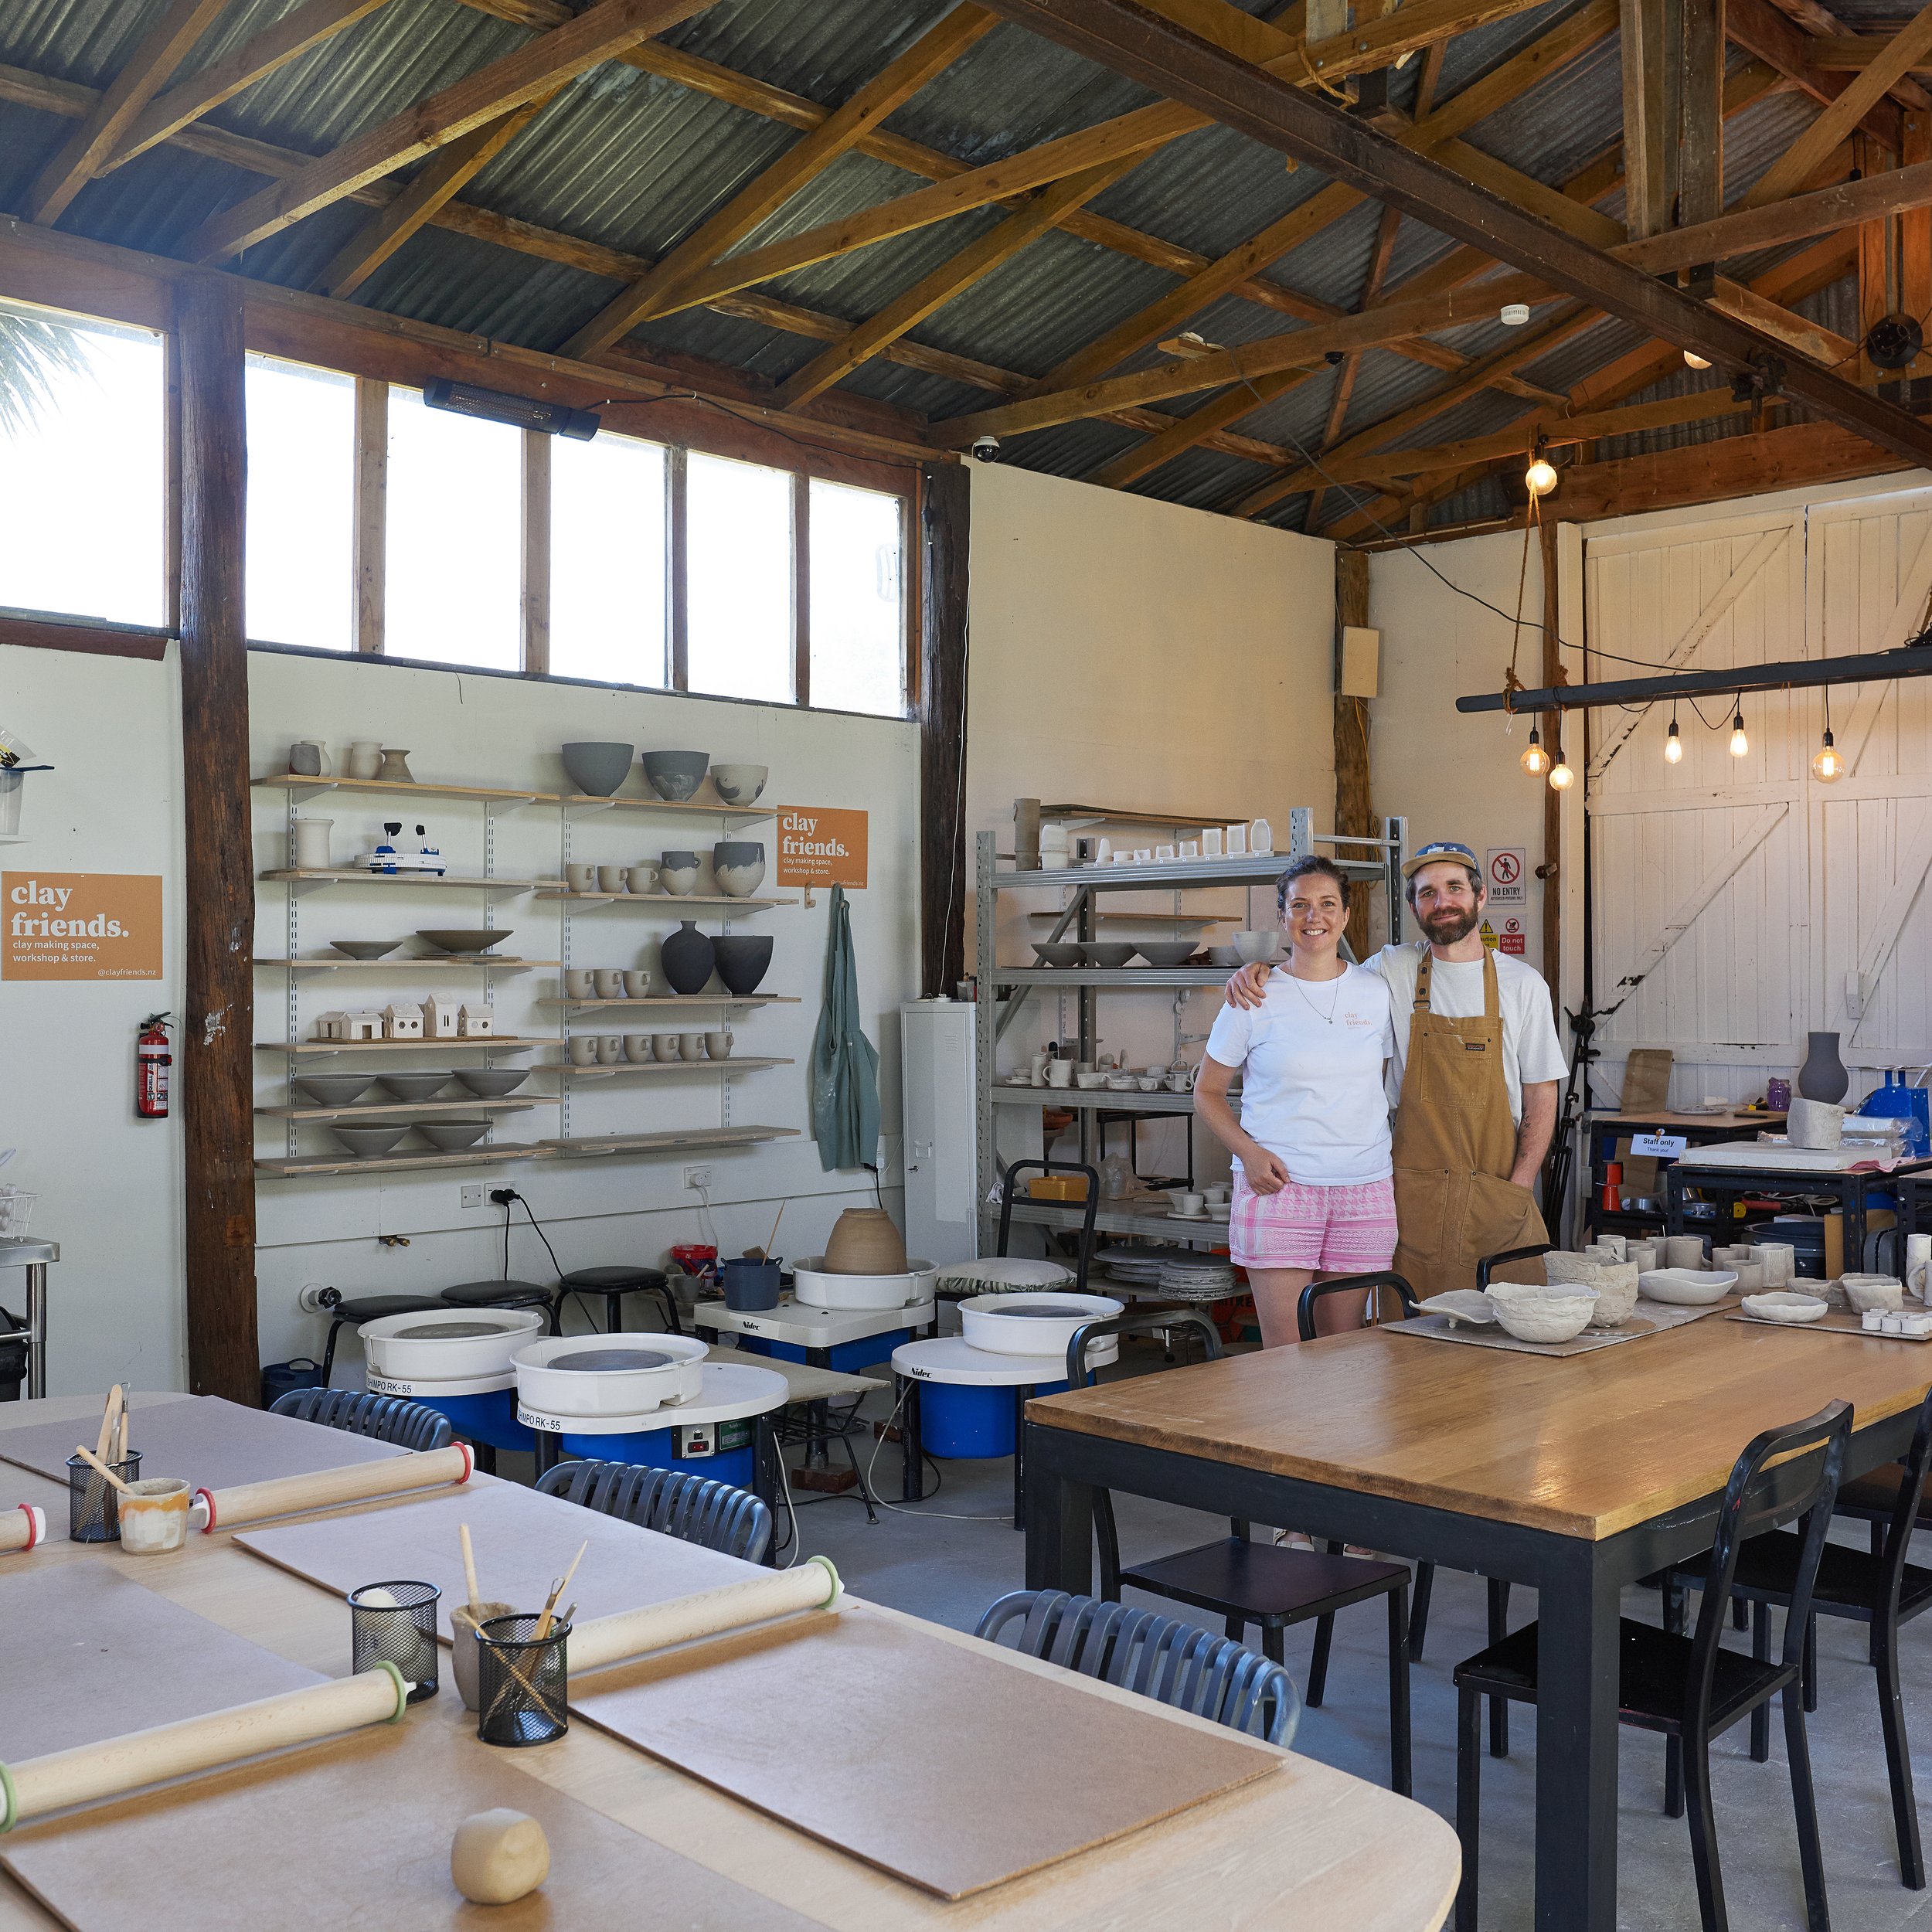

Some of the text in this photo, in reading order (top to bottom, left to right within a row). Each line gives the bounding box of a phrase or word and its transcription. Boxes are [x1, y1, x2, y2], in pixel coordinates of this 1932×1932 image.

[782, 812, 818, 836] clay
[782, 835, 849, 857] friends.
[11, 880, 73, 912] clay
[1492, 886, 1521, 896] NO ENTRY
[11, 911, 129, 937] friends.
[12, 940, 100, 951] clay making space,
[12, 954, 60, 964] workshop
[97, 968, 156, 977] @clayfriends.nz
[742, 1321, 760, 1331] Nidec
[910, 1367, 933, 1379] Nidec
[367, 1377, 412, 1394] SHIMPO RK-55
[536, 1417, 560, 1430] RK-55
